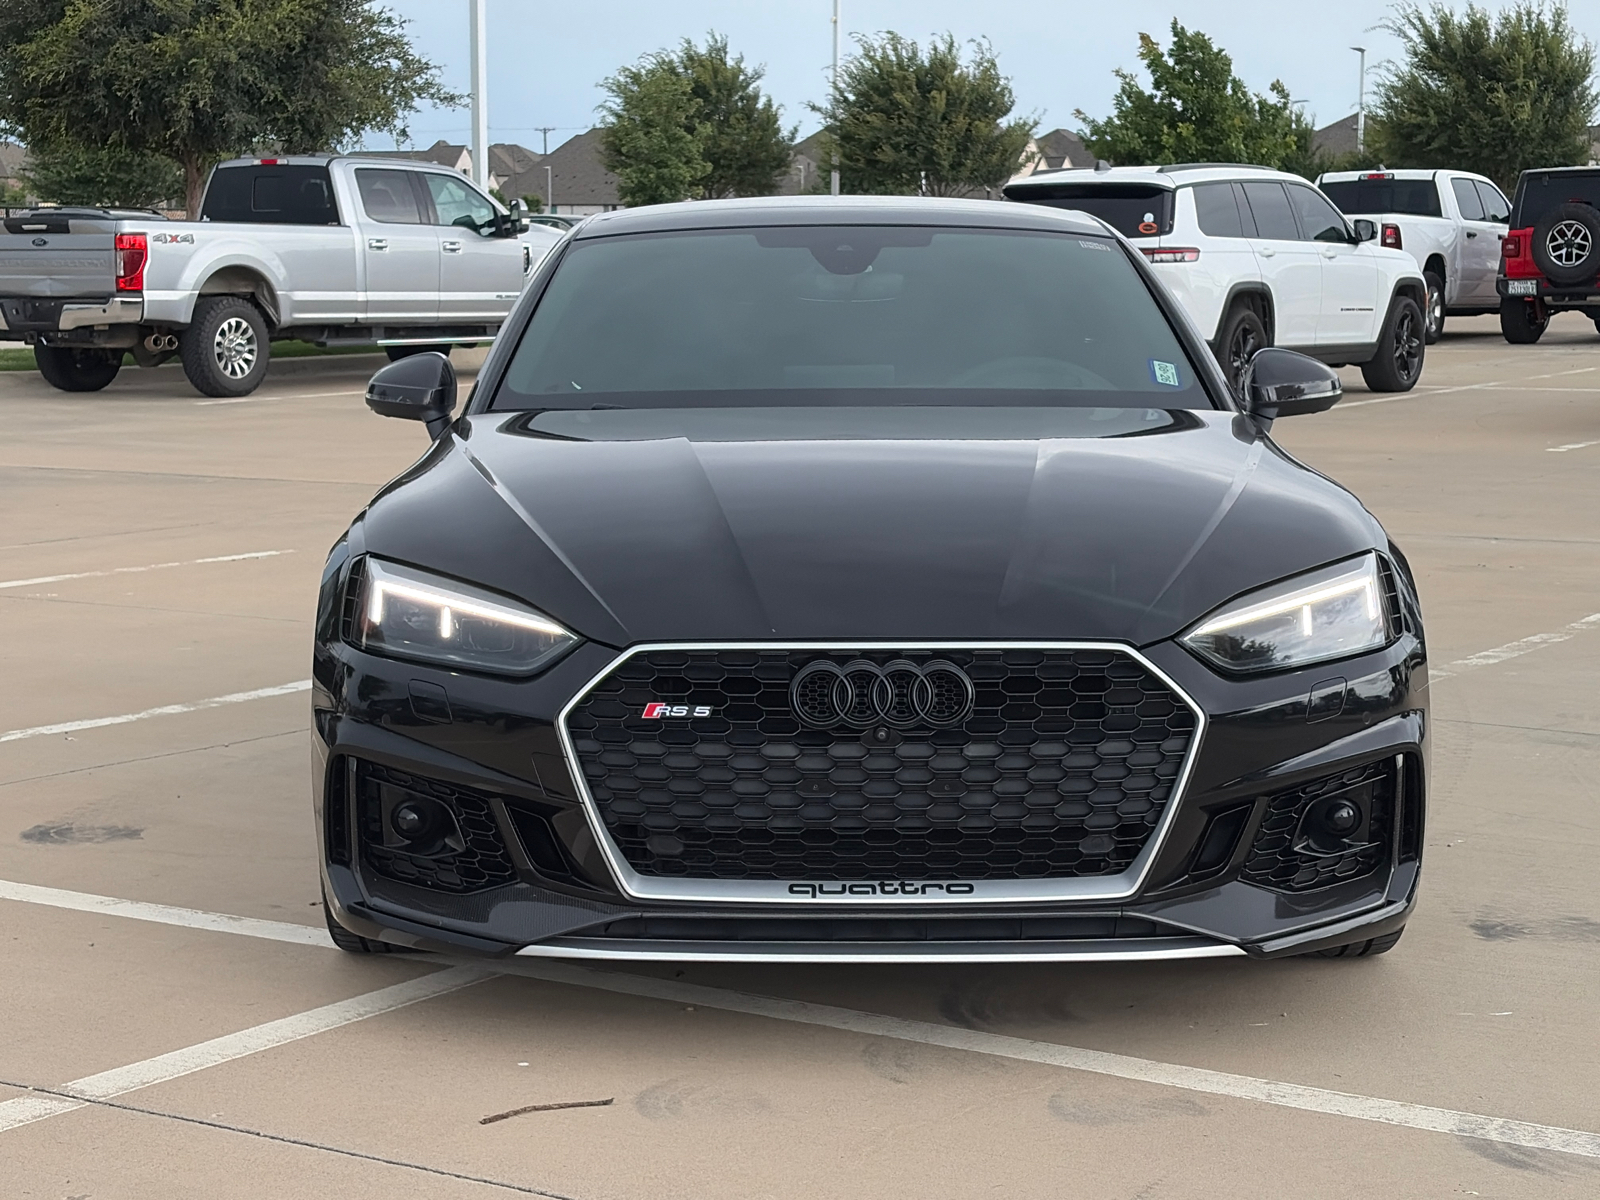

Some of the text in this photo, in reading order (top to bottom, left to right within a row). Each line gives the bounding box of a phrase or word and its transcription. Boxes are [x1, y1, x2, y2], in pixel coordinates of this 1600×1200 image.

[652, 705, 711, 717] RS 5
[788, 881, 975, 898] quattro
